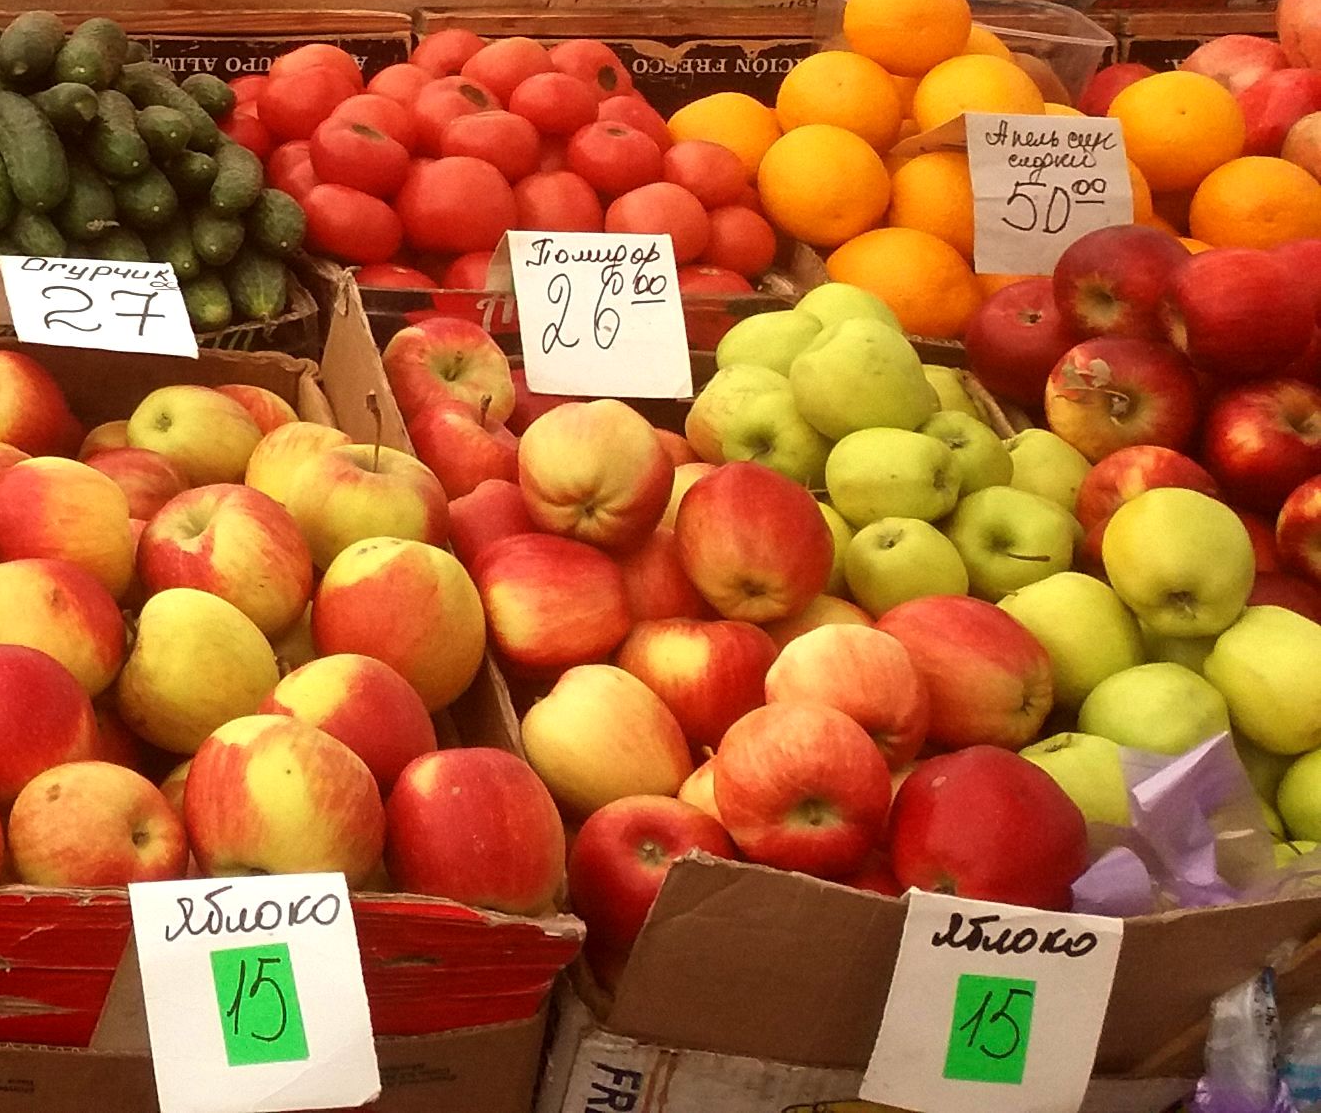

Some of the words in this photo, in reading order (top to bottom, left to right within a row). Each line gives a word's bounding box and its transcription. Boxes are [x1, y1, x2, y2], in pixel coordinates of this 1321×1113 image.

[632, 58, 727, 74] FRESCO
[1002, 181, 1071, 234] 50
[21, 257, 169, 281] Огурчик
[42, 285, 166, 337] 27
[542, 261, 625, 355] 26
[165, 885, 341, 942] Яблоко
[931, 912, 1098, 958] Яблоко
[227, 958, 288, 1042] 15
[960, 988, 1033, 1060] 15
